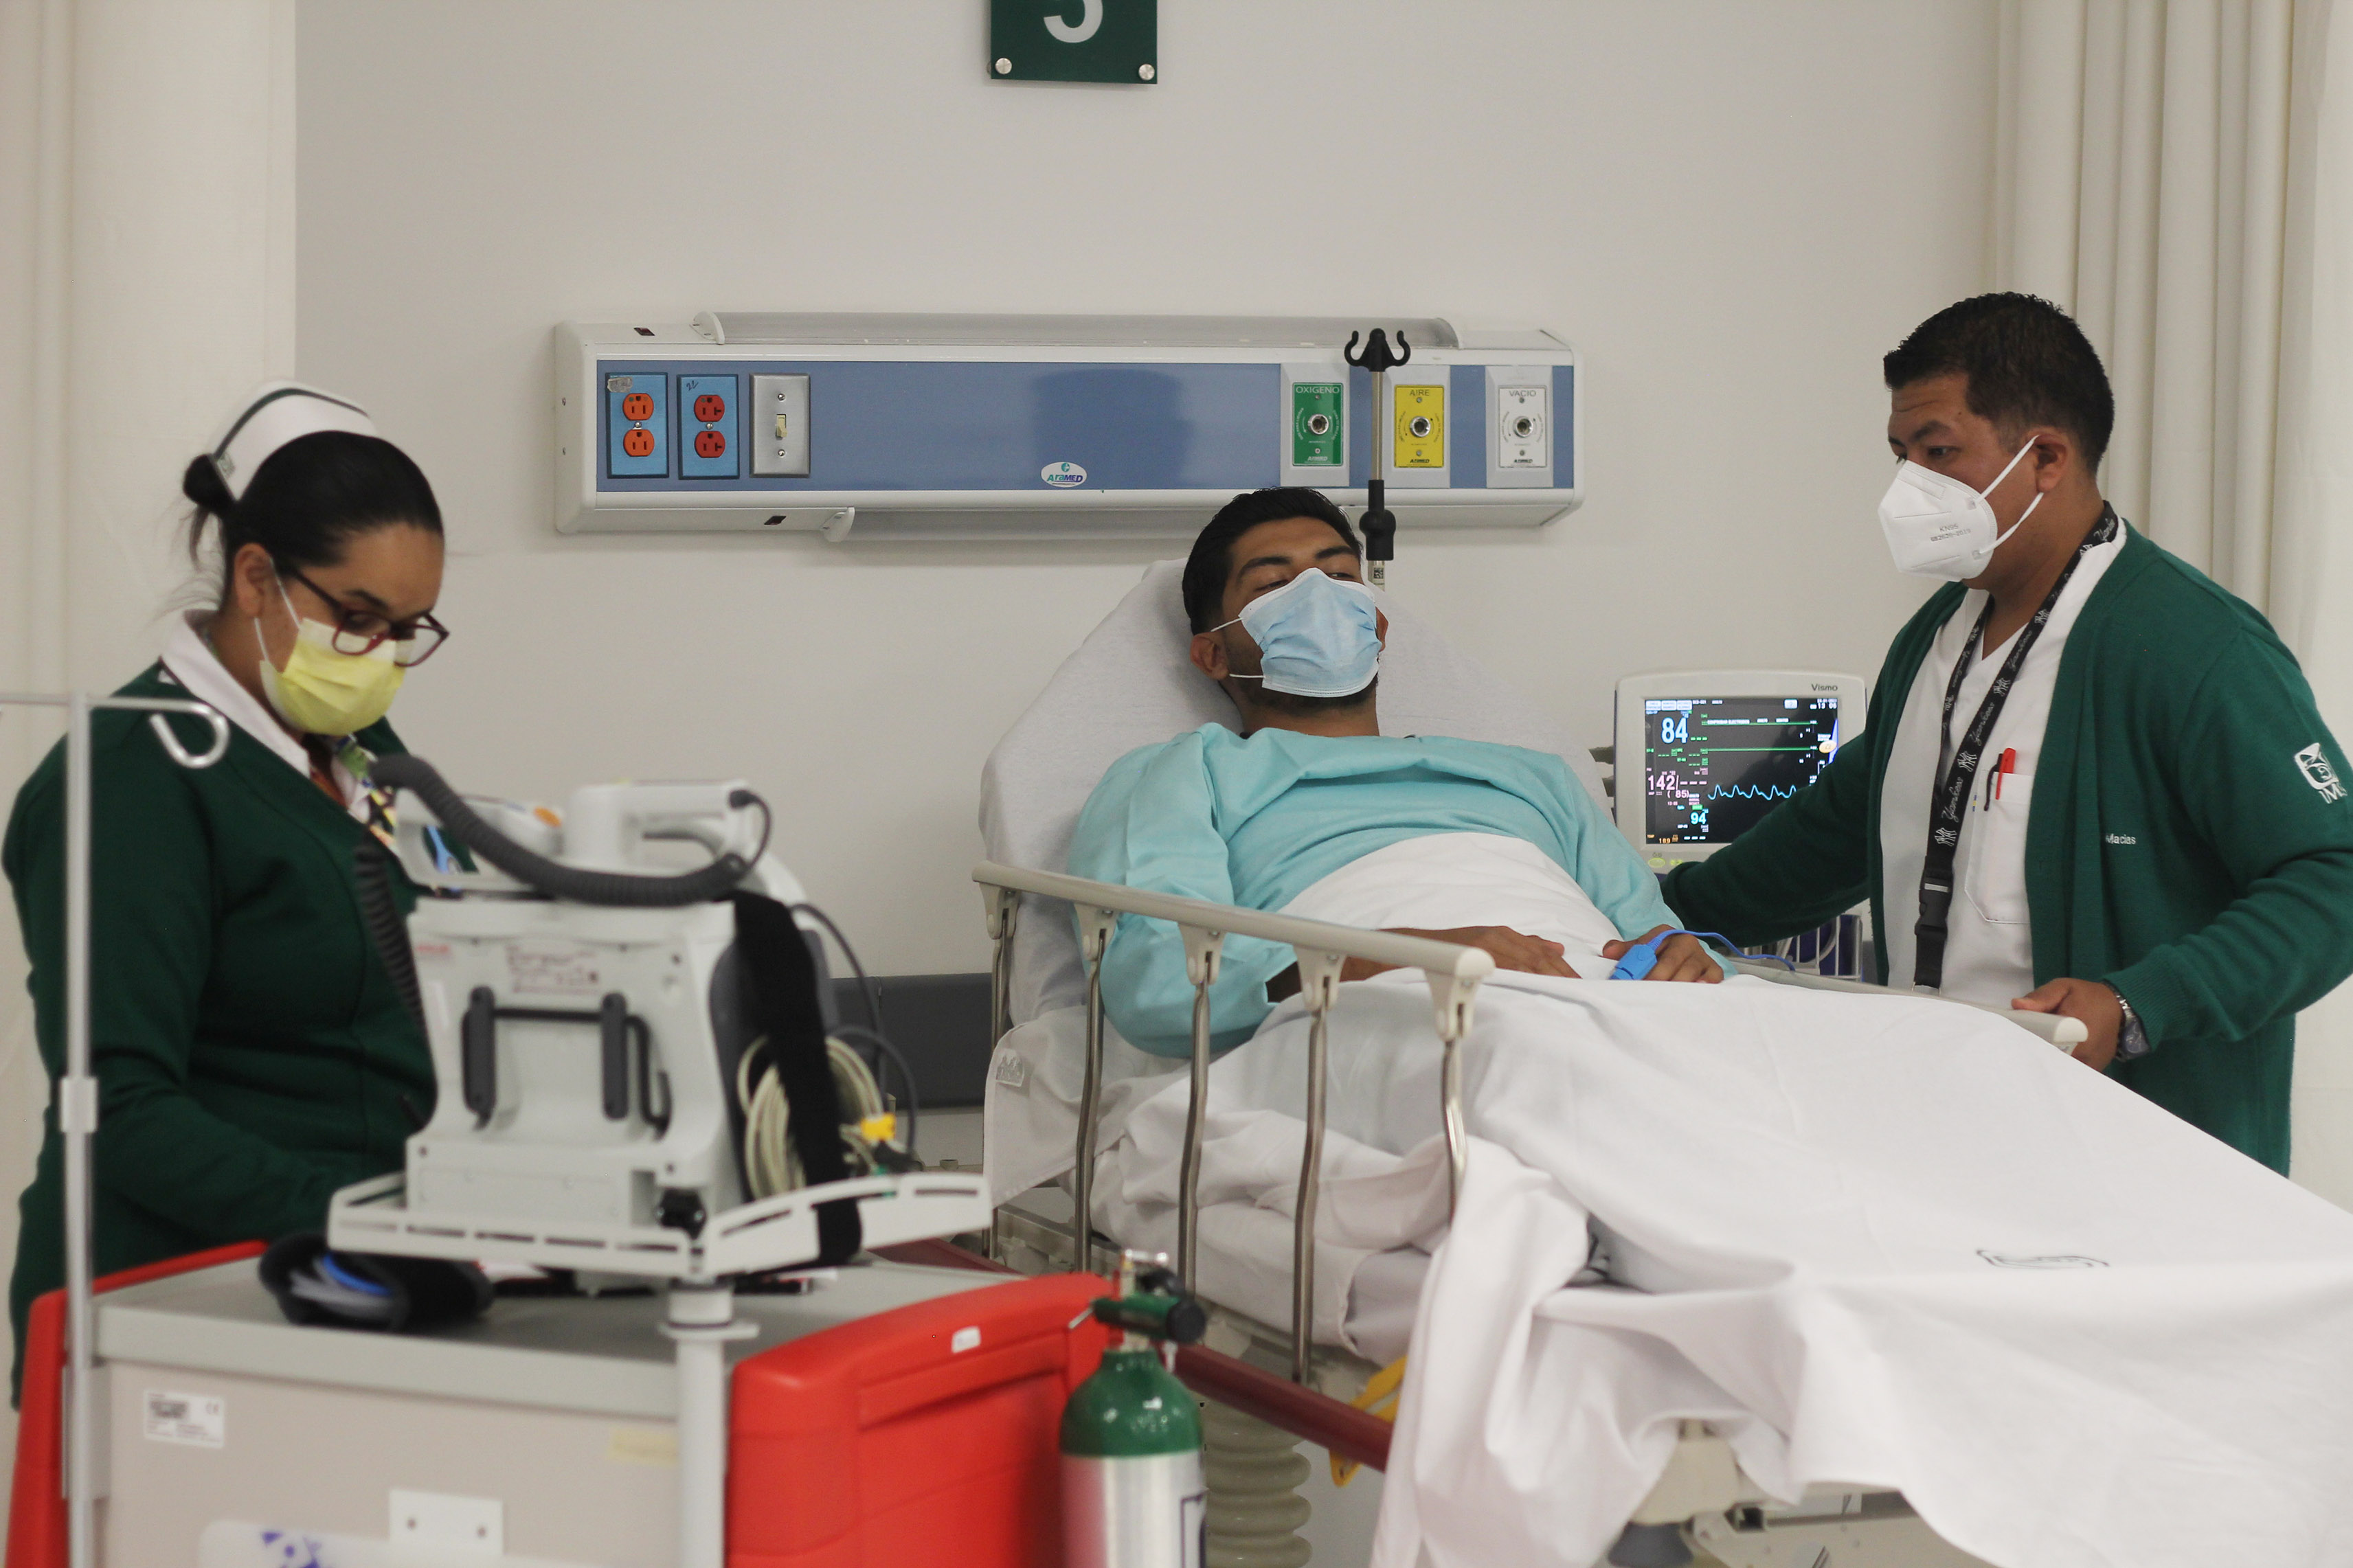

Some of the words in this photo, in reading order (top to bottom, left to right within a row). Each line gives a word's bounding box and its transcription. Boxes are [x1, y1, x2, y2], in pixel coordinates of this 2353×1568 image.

[1047, 474, 1083, 482] AraMED
[1661, 717, 1688, 744] 84
[1941, 777, 1963, 823] Yankees
[1690, 812, 1707, 824] 94
[2106, 833, 2136, 845] Macias
